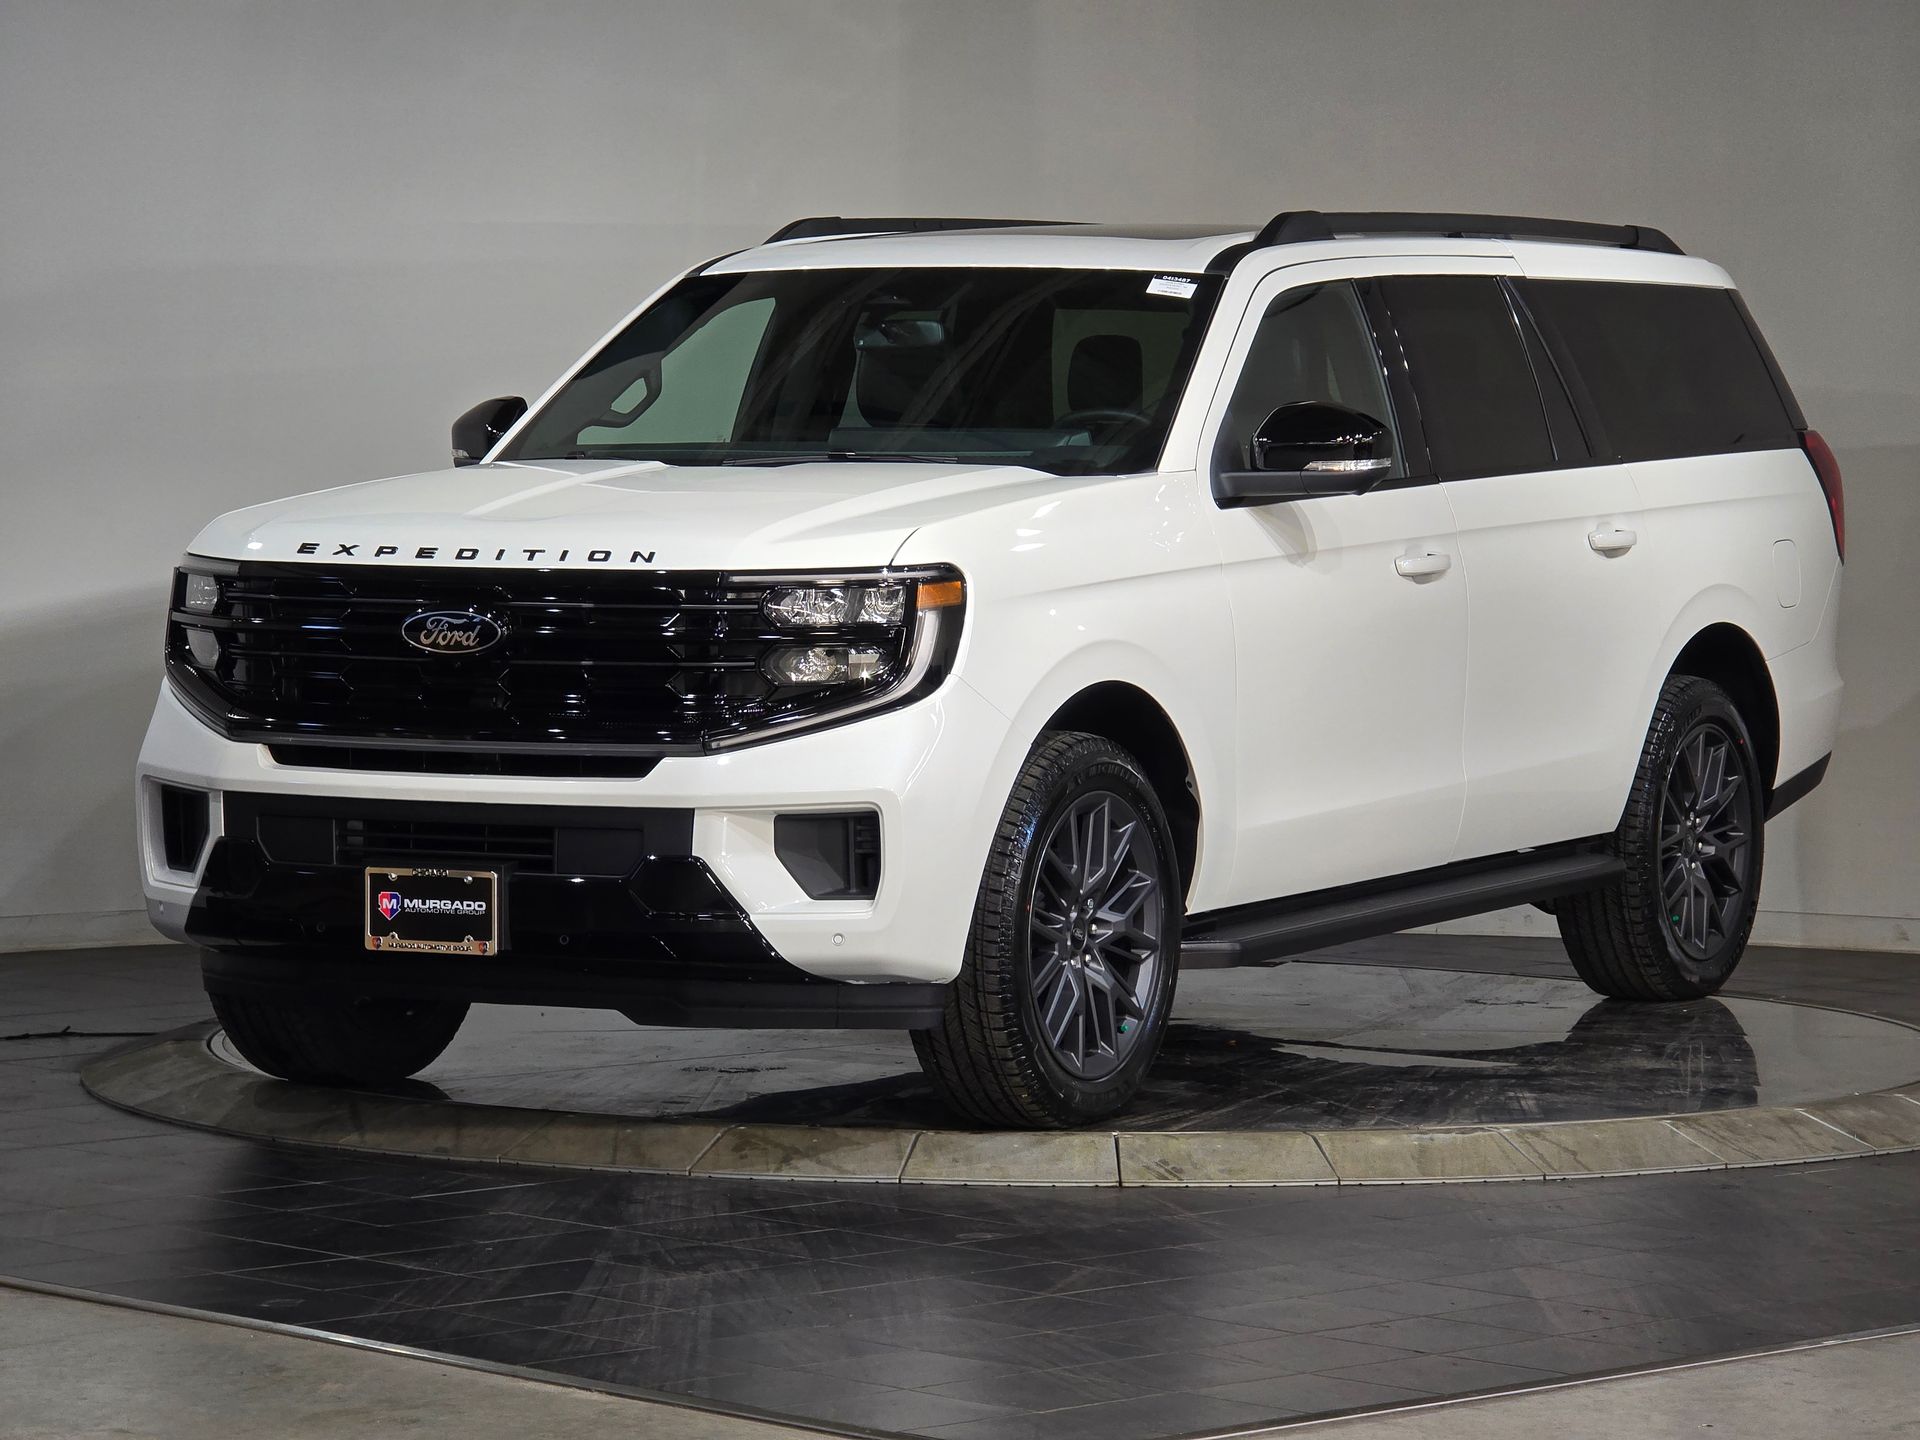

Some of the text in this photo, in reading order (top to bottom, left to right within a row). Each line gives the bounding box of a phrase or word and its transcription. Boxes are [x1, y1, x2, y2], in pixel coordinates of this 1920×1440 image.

[297, 542, 656, 564] EXPEDITION
[419, 616, 480, 647] Ford
[382, 898, 397, 909] M
[404, 898, 487, 911] MURGADO
[405, 907, 486, 916] AUTOMOTIVE GROUP
